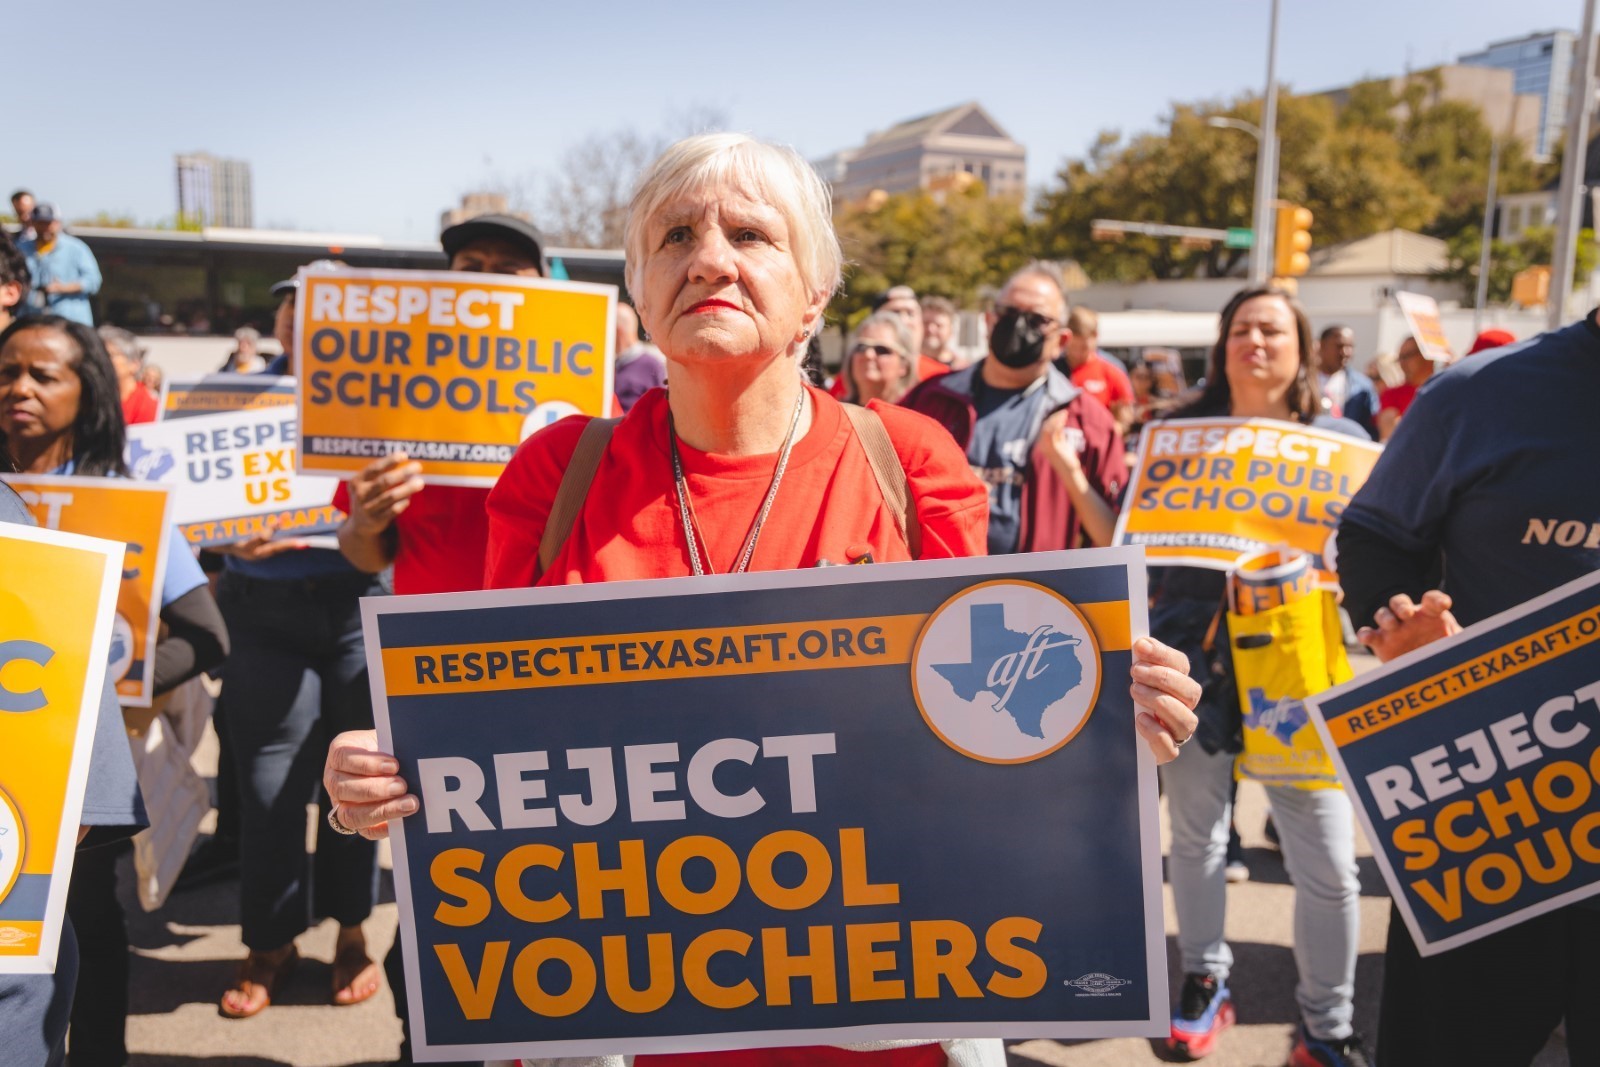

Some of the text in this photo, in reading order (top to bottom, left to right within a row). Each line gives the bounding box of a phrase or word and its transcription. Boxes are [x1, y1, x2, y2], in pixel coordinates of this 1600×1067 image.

[312, 284, 524, 330] RESPECT
[310, 329, 594, 376] OUR PUBLIC
[310, 371, 537, 415] SCHOOLS
[312, 437, 512, 462] RESPECT.TEXASAFT.ORG
[1152, 427, 1341, 466] RESPECT
[187, 457, 234, 483] US
[245, 479, 291, 505] US
[1147, 458, 1235, 483] OUR
[1138, 487, 1347, 529] SCHOOLS
[414, 626, 886, 685] RESPECT.TEXASAFT.ORG
[986, 624, 1082, 713] aft
[1347, 611, 1600, 733] RESPECT.TEXASAFT.O
[417, 732, 836, 835] REJECT
[1392, 745, 1600, 872] SCHO
[429, 827, 900, 927] SCHOOL
[433, 916, 1048, 1021] VOUCHERS
